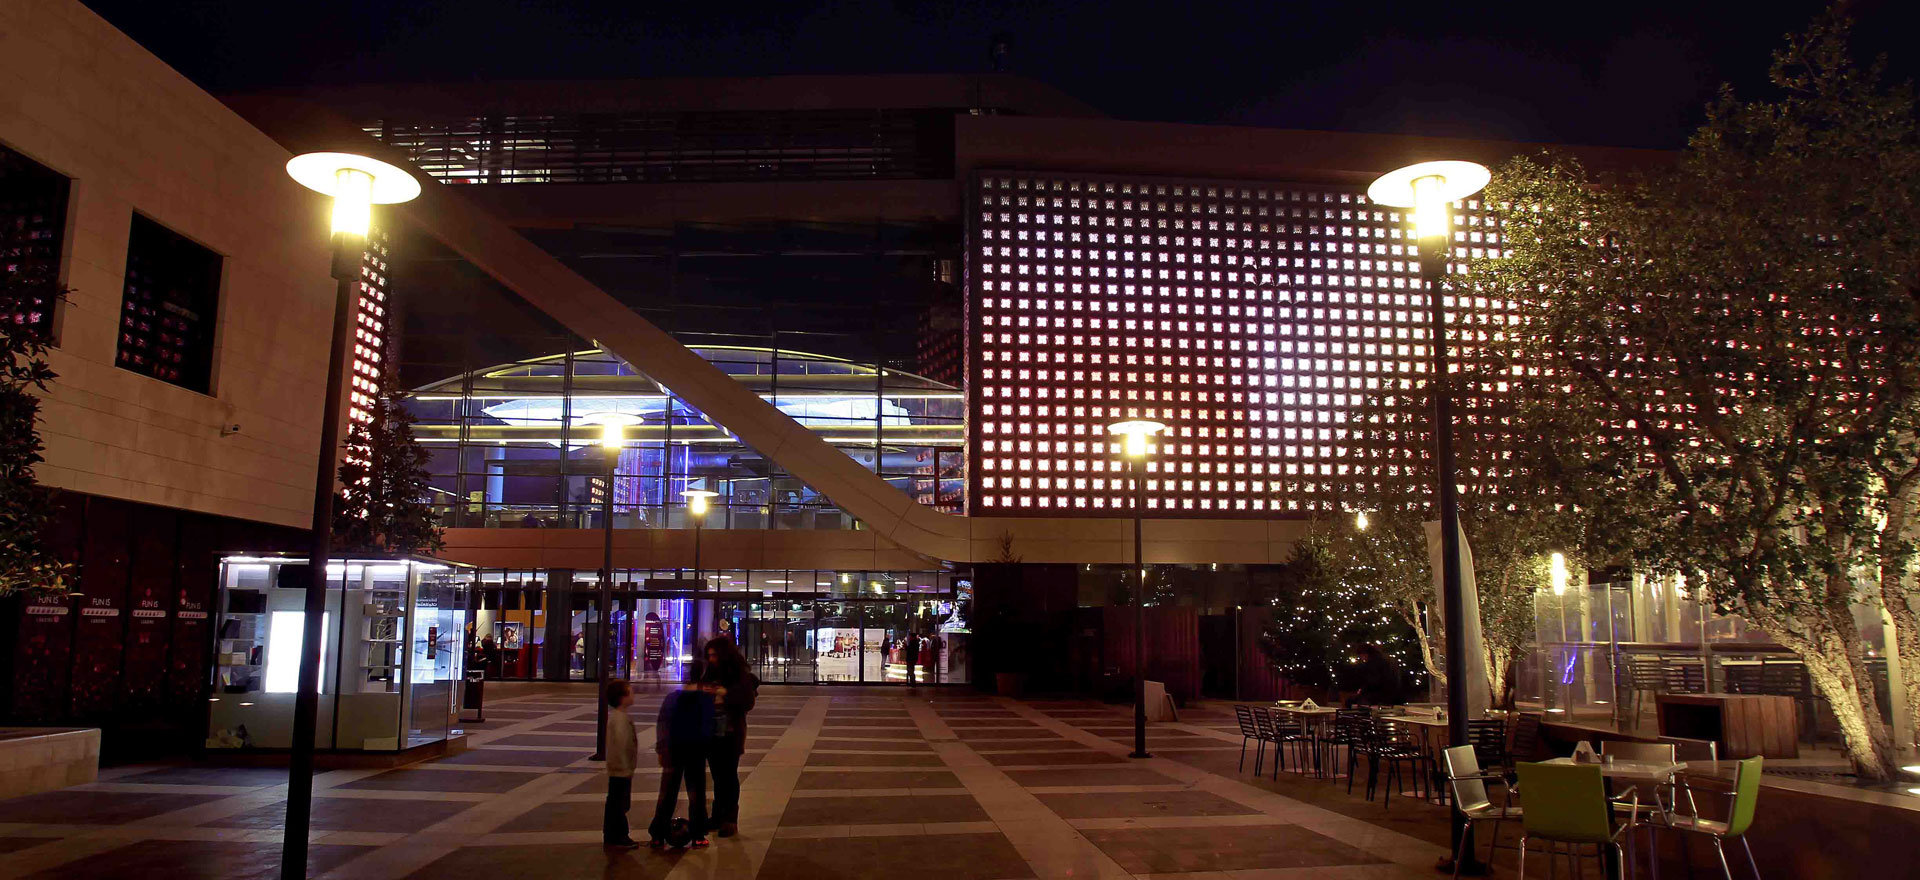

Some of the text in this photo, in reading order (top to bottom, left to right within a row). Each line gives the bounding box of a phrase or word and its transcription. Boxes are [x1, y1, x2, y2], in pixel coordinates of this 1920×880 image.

[38, 596, 59, 604] FUN IS
[92, 598, 111, 606] FUN IS
[141, 600, 159, 608] FUN IS
